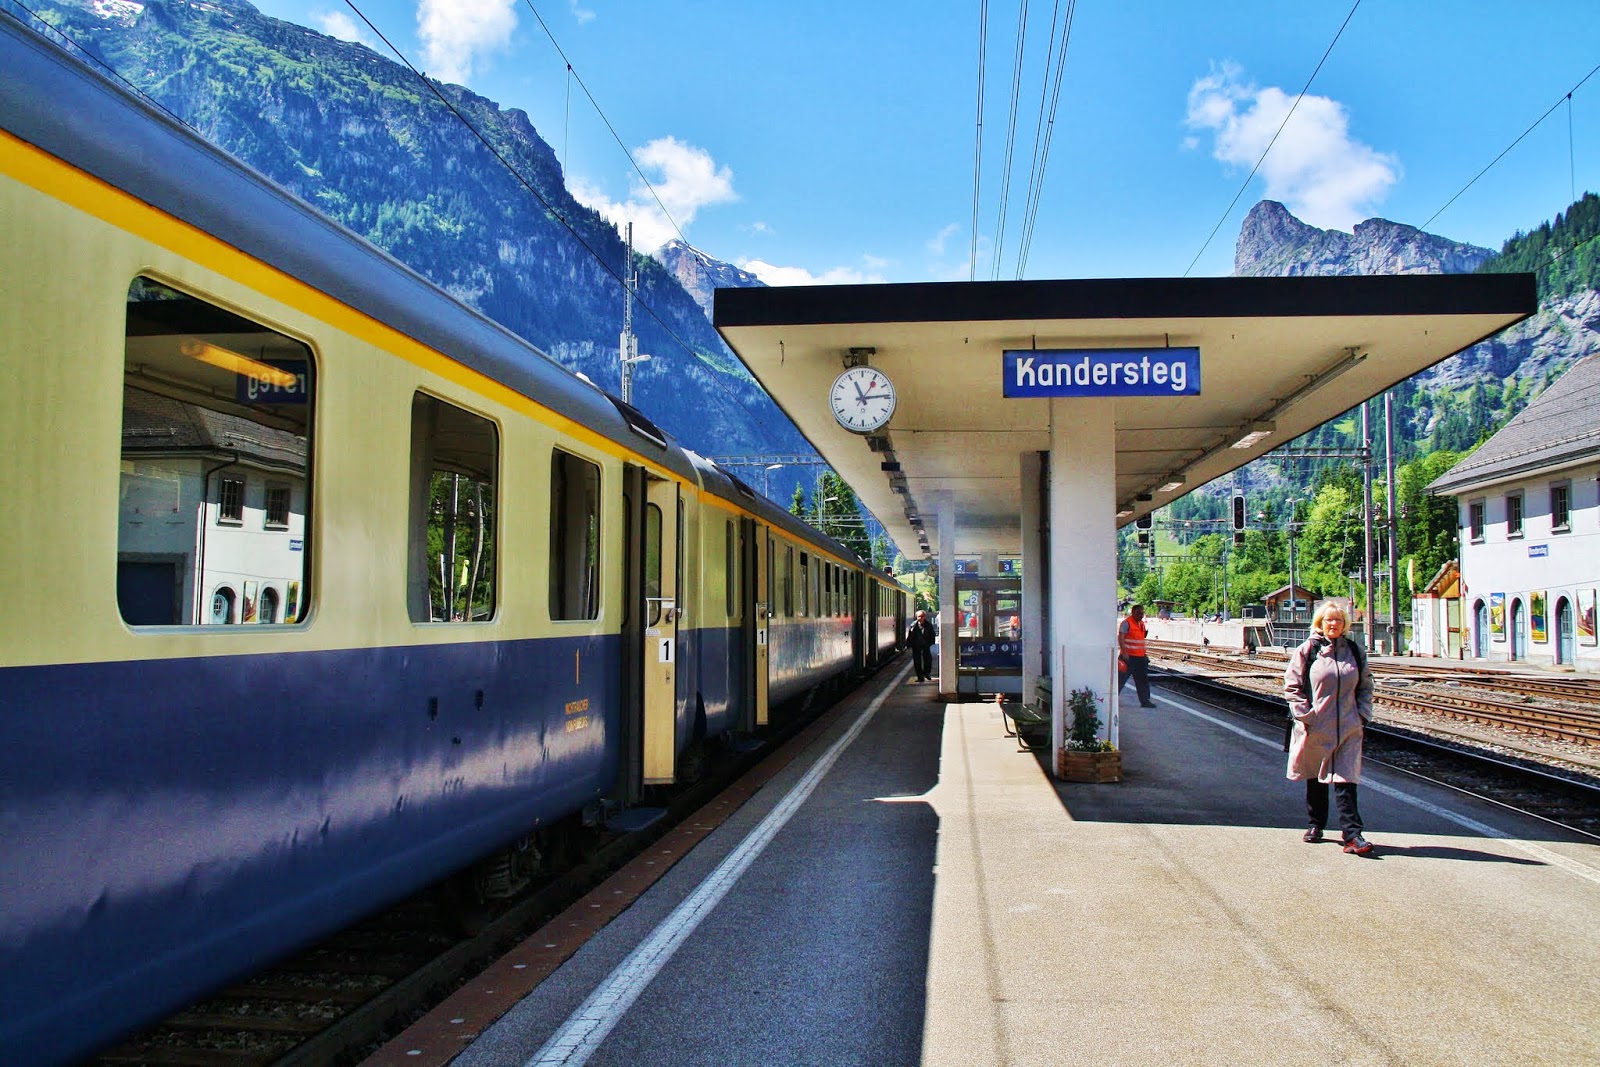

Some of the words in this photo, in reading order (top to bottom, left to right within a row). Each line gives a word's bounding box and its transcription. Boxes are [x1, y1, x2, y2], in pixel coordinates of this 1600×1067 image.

[1016, 355, 1187, 391] Kandersteg
[760, 630, 764, 644] 1
[663, 640, 670, 661] 1
